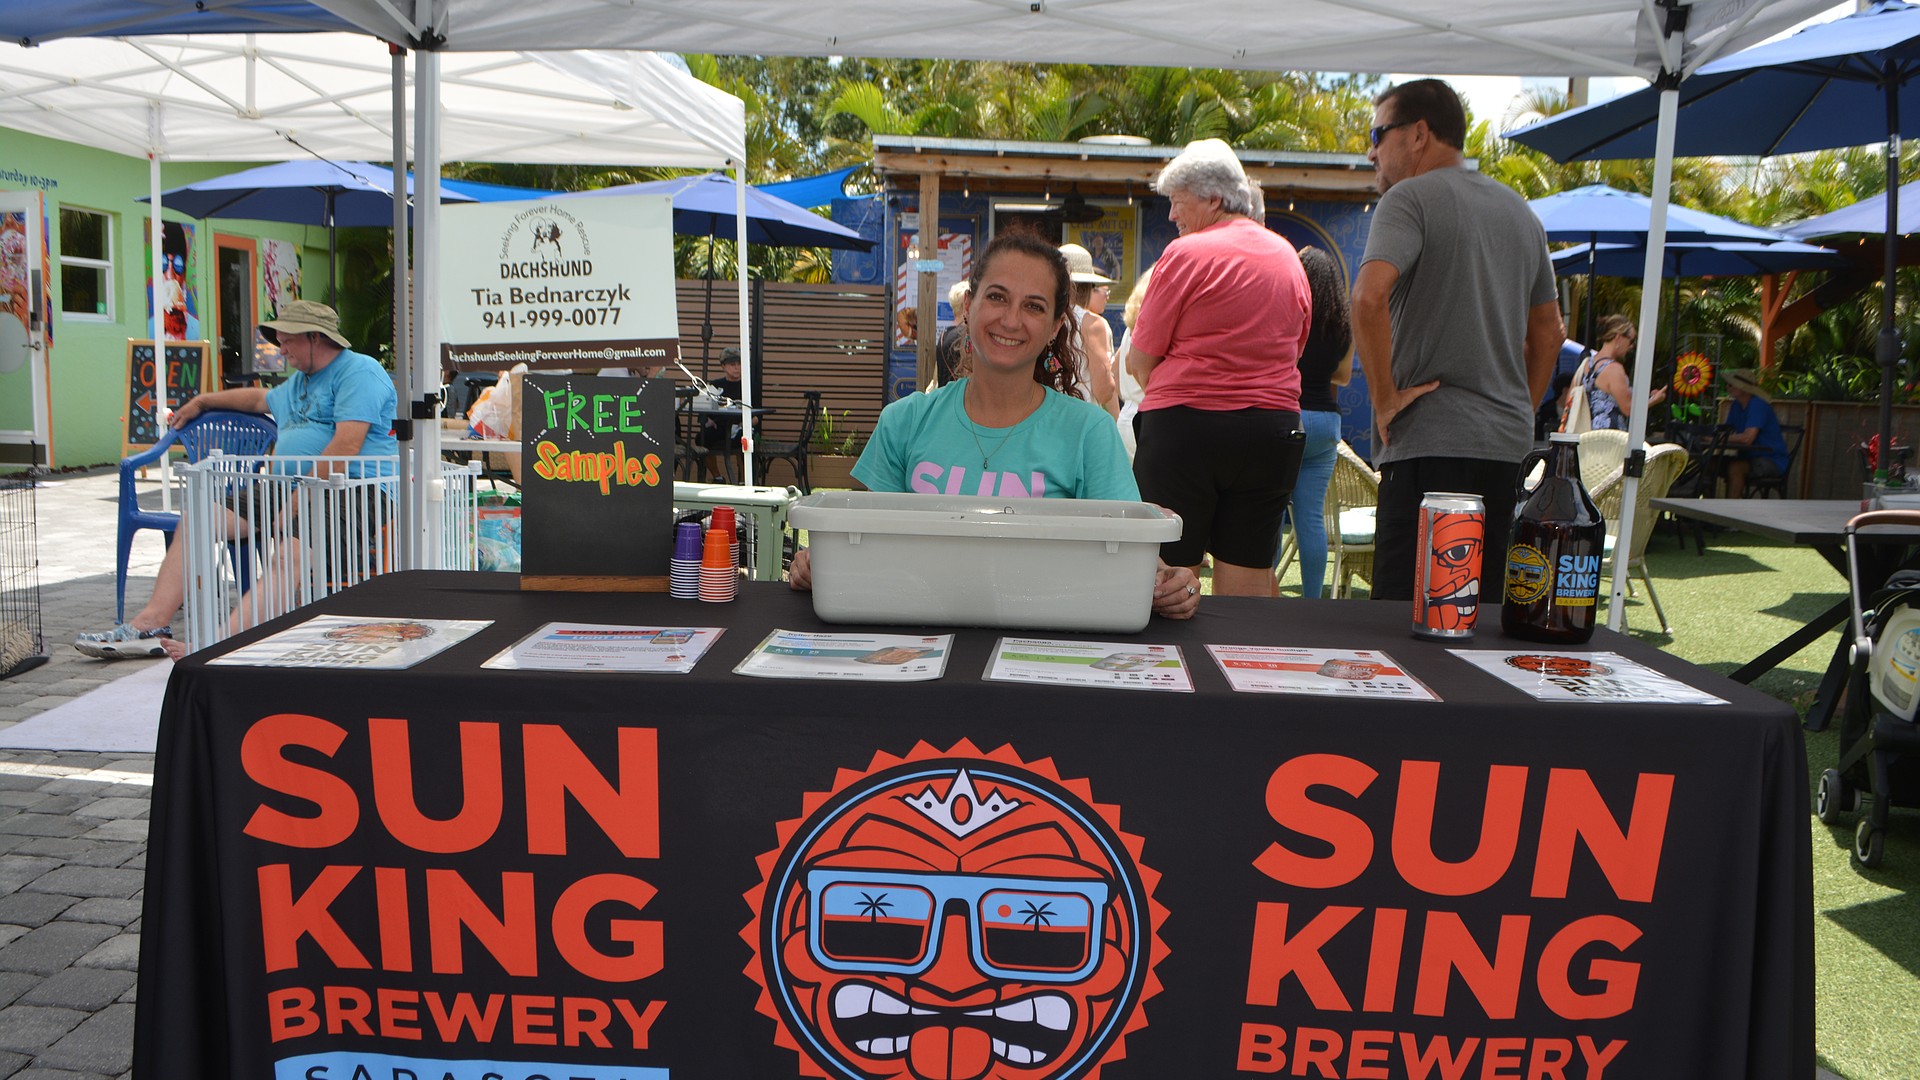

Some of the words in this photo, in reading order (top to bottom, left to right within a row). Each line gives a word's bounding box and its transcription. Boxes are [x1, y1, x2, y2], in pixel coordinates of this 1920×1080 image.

[30, 175, 58, 191] 10-3pm
[500, 221, 519, 260] Seeking
[514, 206, 547, 224] Forever
[550, 204, 576, 224] Home
[575, 221, 591, 256] Rescue
[500, 259, 593, 279] DACHSHUND
[471, 287, 503, 306] Tia
[510, 283, 631, 307] Bednarczyk
[482, 307, 622, 329] 941-999-0077
[140, 361, 197, 388] OEN
[543, 388, 643, 433] FREE
[533, 440, 662, 496] Samples
[1557, 554, 1600, 573] SUN
[1556, 588, 1596, 598] BREWERY
[1557, 573, 1598, 589] KING
[280, 650, 380, 660] KING
[296, 643, 397, 654] SUN
[241, 713, 660, 859] SUN
[1251, 753, 1676, 903] SUN
[257, 863, 664, 982] KING
[1245, 901, 1644, 1021] KING
[267, 985, 668, 1050] BREWERY
[1236, 1022, 1629, 1080] BREWERY
